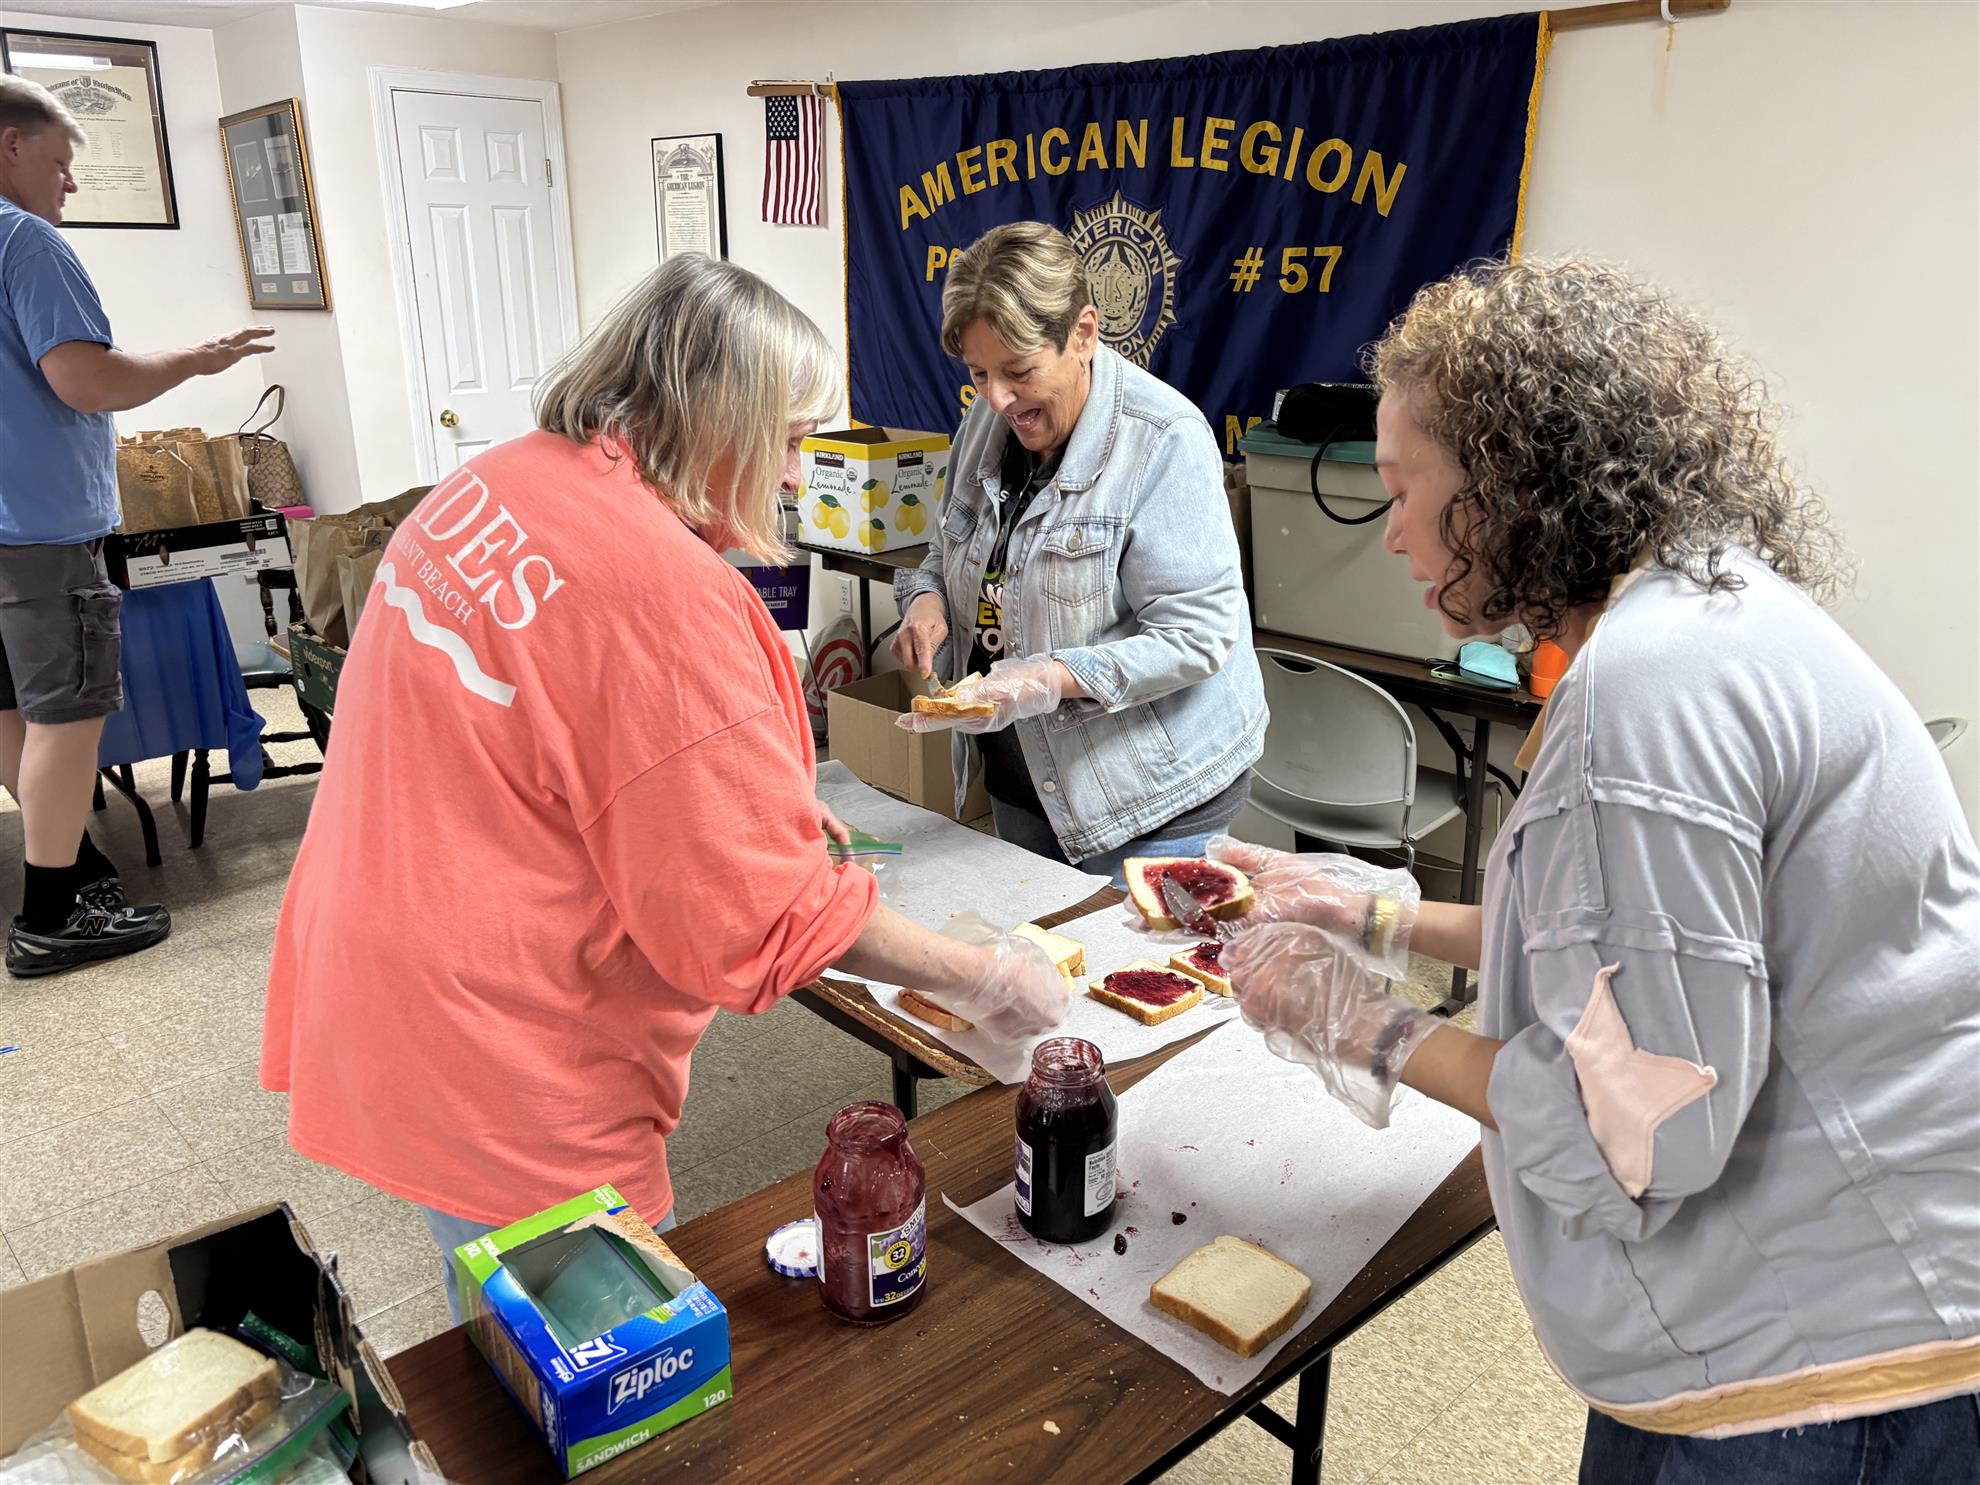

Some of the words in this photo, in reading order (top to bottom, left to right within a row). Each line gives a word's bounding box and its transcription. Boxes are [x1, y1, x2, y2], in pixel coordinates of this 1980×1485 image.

[900, 119, 1149, 231] AMERICAN
[1170, 116, 1408, 217] LEGION
[1075, 217, 1163, 276] MERICAN
[1230, 246, 1264, 292] #
[1280, 245, 1343, 293] 57
[815, 466, 845, 479] Organic
[897, 468, 922, 480] Organic
[417, 560, 476, 626] BEACH
[756, 587, 777, 598] ABLE
[778, 586, 798, 598] TRAY
[892, 1248, 905, 1260] 32
[884, 1291, 897, 1301] 32
[613, 1348, 695, 1405] Ziploc
[703, 1389, 726, 1408] 120
[576, 1428, 651, 1474] SANDWICH
